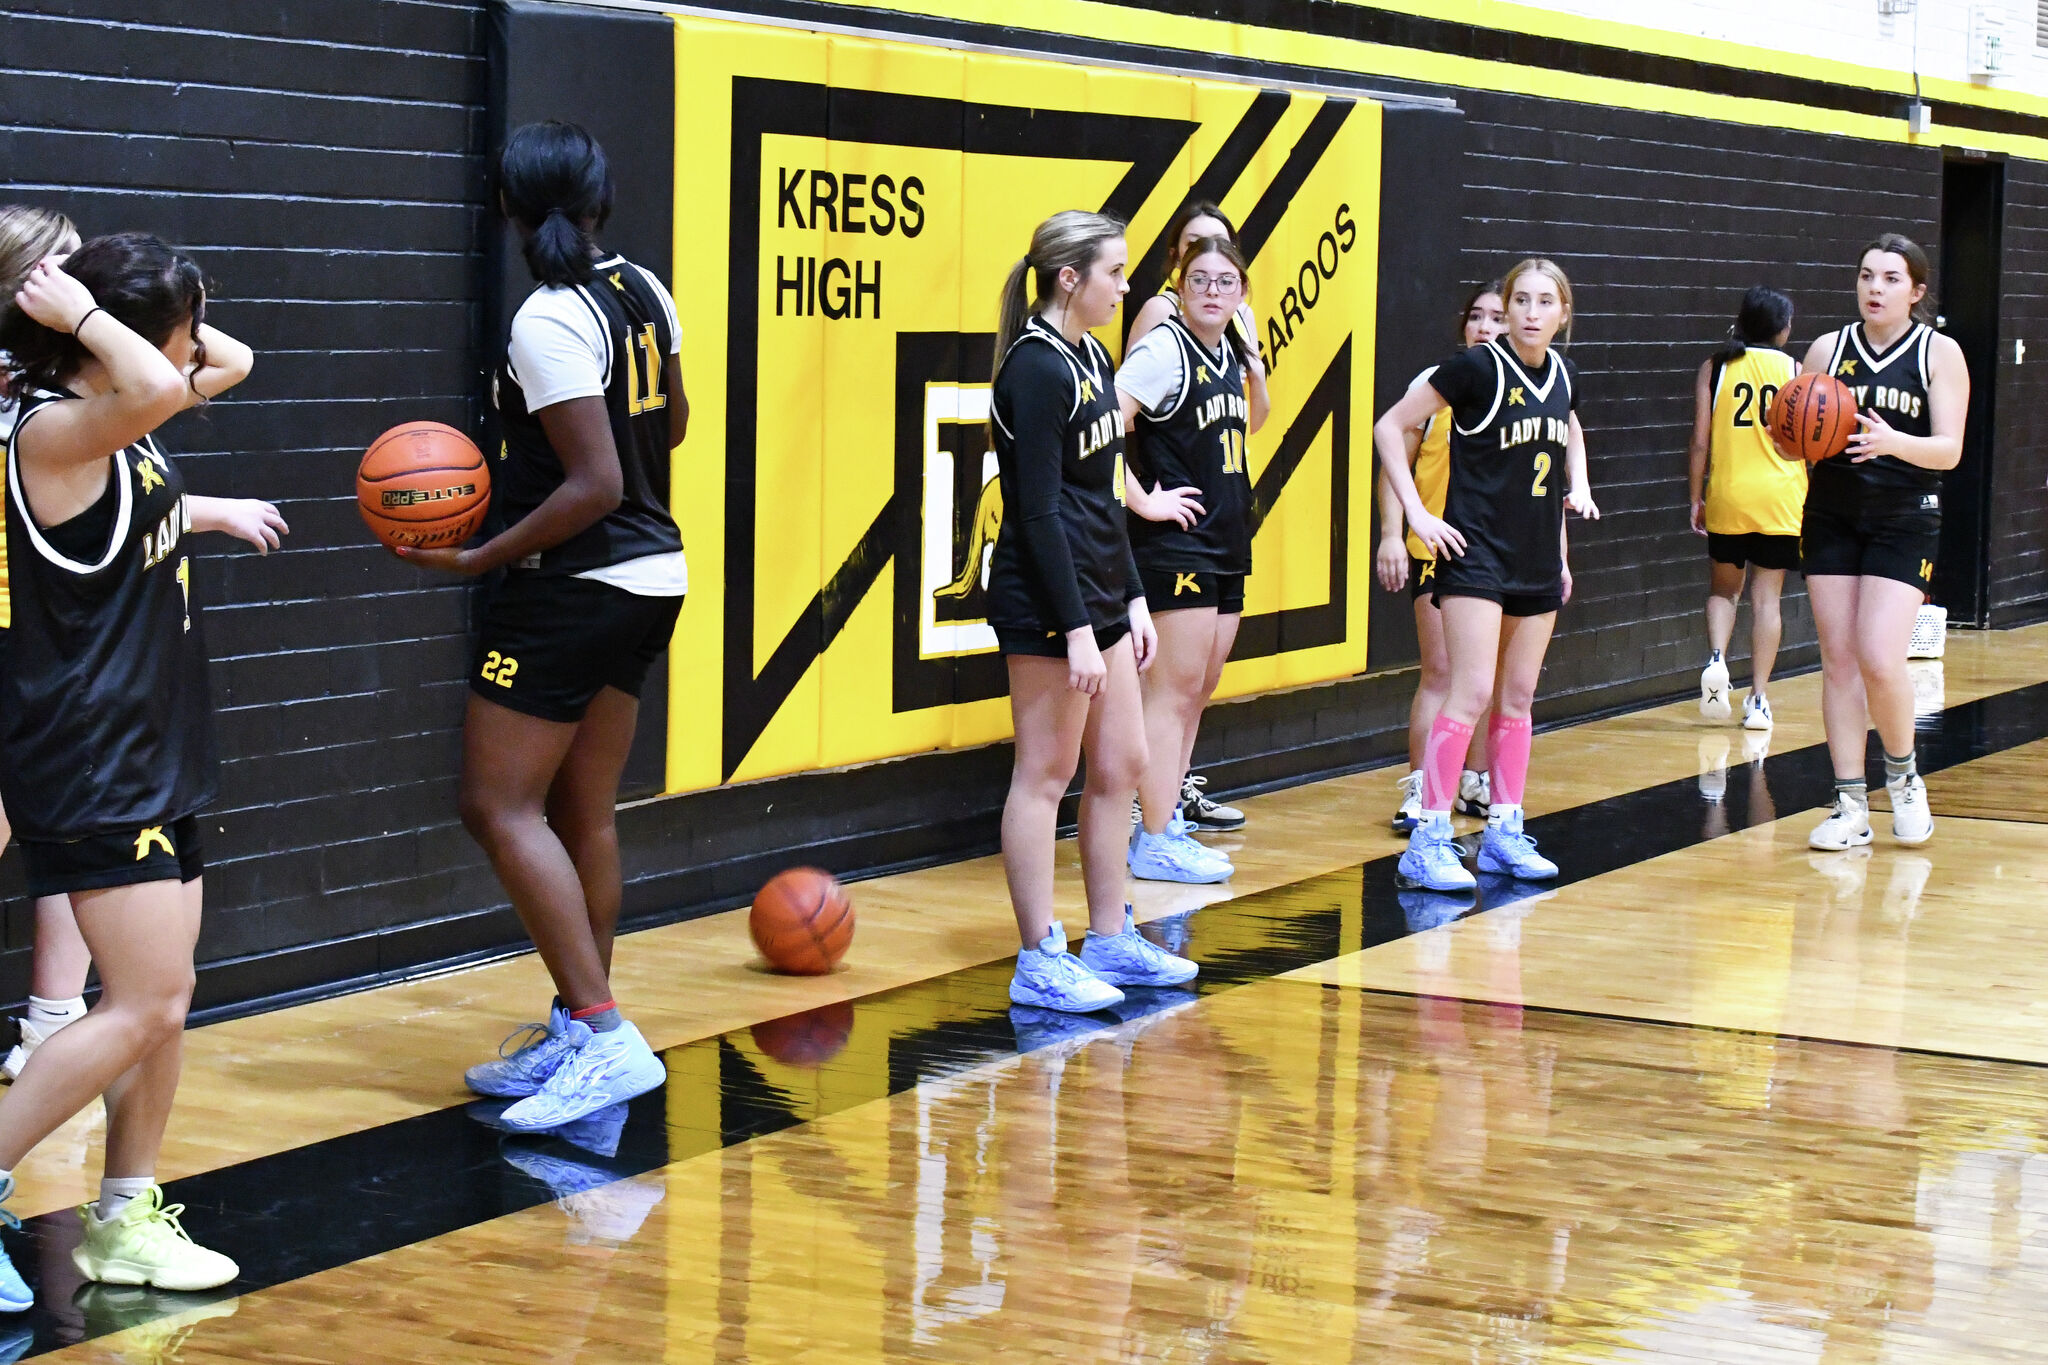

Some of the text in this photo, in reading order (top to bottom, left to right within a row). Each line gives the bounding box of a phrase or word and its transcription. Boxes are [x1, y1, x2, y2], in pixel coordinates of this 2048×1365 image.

[778, 167, 925, 238] KRESS
[776, 255, 881, 320] HIGH
[625, 322, 667, 417] 11
[1196, 393, 1226, 430] LADY
[1733, 382, 1779, 428] 20
[1875, 385, 1921, 418] ROOS
[1079, 411, 1113, 460] LADY
[1219, 429, 1244, 474] 10
[1500, 416, 1569, 450] LADY ROO
[382, 484, 476, 506] ELITE PRO
[1531, 451, 1552, 497] 2
[481, 650, 519, 689] 22
